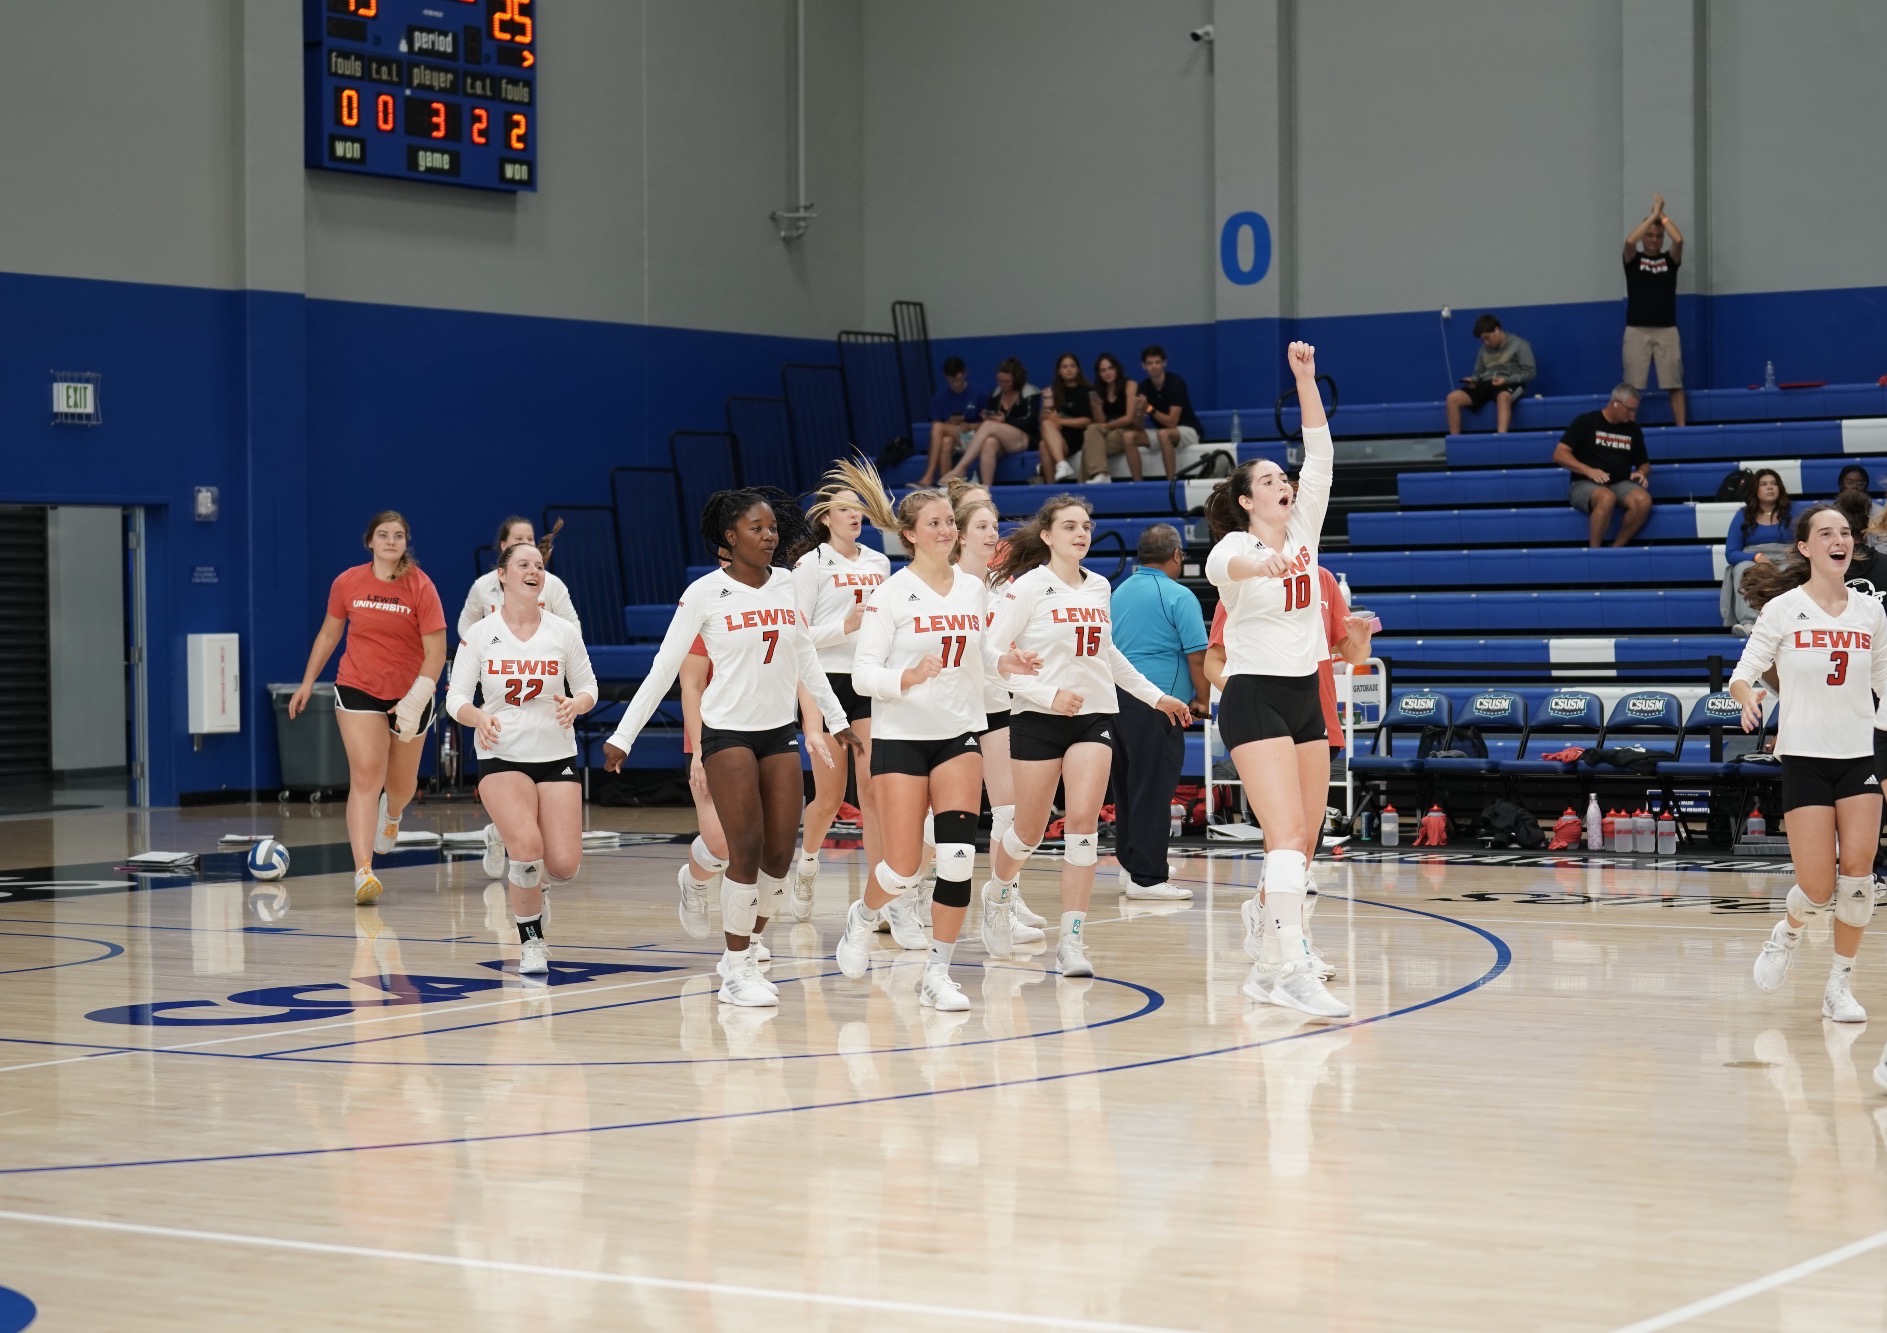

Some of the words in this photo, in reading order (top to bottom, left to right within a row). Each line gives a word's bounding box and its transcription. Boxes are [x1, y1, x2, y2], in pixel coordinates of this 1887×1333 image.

[413, 31, 453, 53] period
[331, 51, 362, 77] fouls
[412, 66, 454, 90] player
[501, 79, 529, 102] fouls
[341, 89, 359, 127] 0
[377, 94, 394, 131] 0
[430, 102, 446, 139] 3
[471, 108, 488, 144] 2
[510, 114, 527, 150] 2
[335, 140, 361, 159] won
[418, 150, 450, 171] game
[504, 163, 529, 181] won
[66, 385, 88, 409] EXIT
[1595, 438, 1631, 450] FLYERS
[367, 594, 400, 605] LEWIS
[1282, 573, 1311, 612] 10
[352, 599, 412, 614] UNIVERSITY
[1051, 607, 1110, 624] LEWIS
[724, 608, 797, 632] LEWIS
[913, 614, 981, 634] LEWIS
[762, 629, 780, 664] 7
[1075, 626, 1102, 657] 15
[1793, 630, 1872, 650] LEWIS
[941, 635, 968, 668] 11
[487, 659, 559, 676] LEWIS
[1826, 650, 1849, 686] 3
[504, 678, 544, 707] 22
[1353, 684, 1379, 692] GATORADE
[1401, 698, 1436, 710] CSUSM
[1475, 698, 1511, 710] CSUSM
[1551, 698, 1586, 710] CSUSM
[1629, 699, 1665, 711] CSUSM
